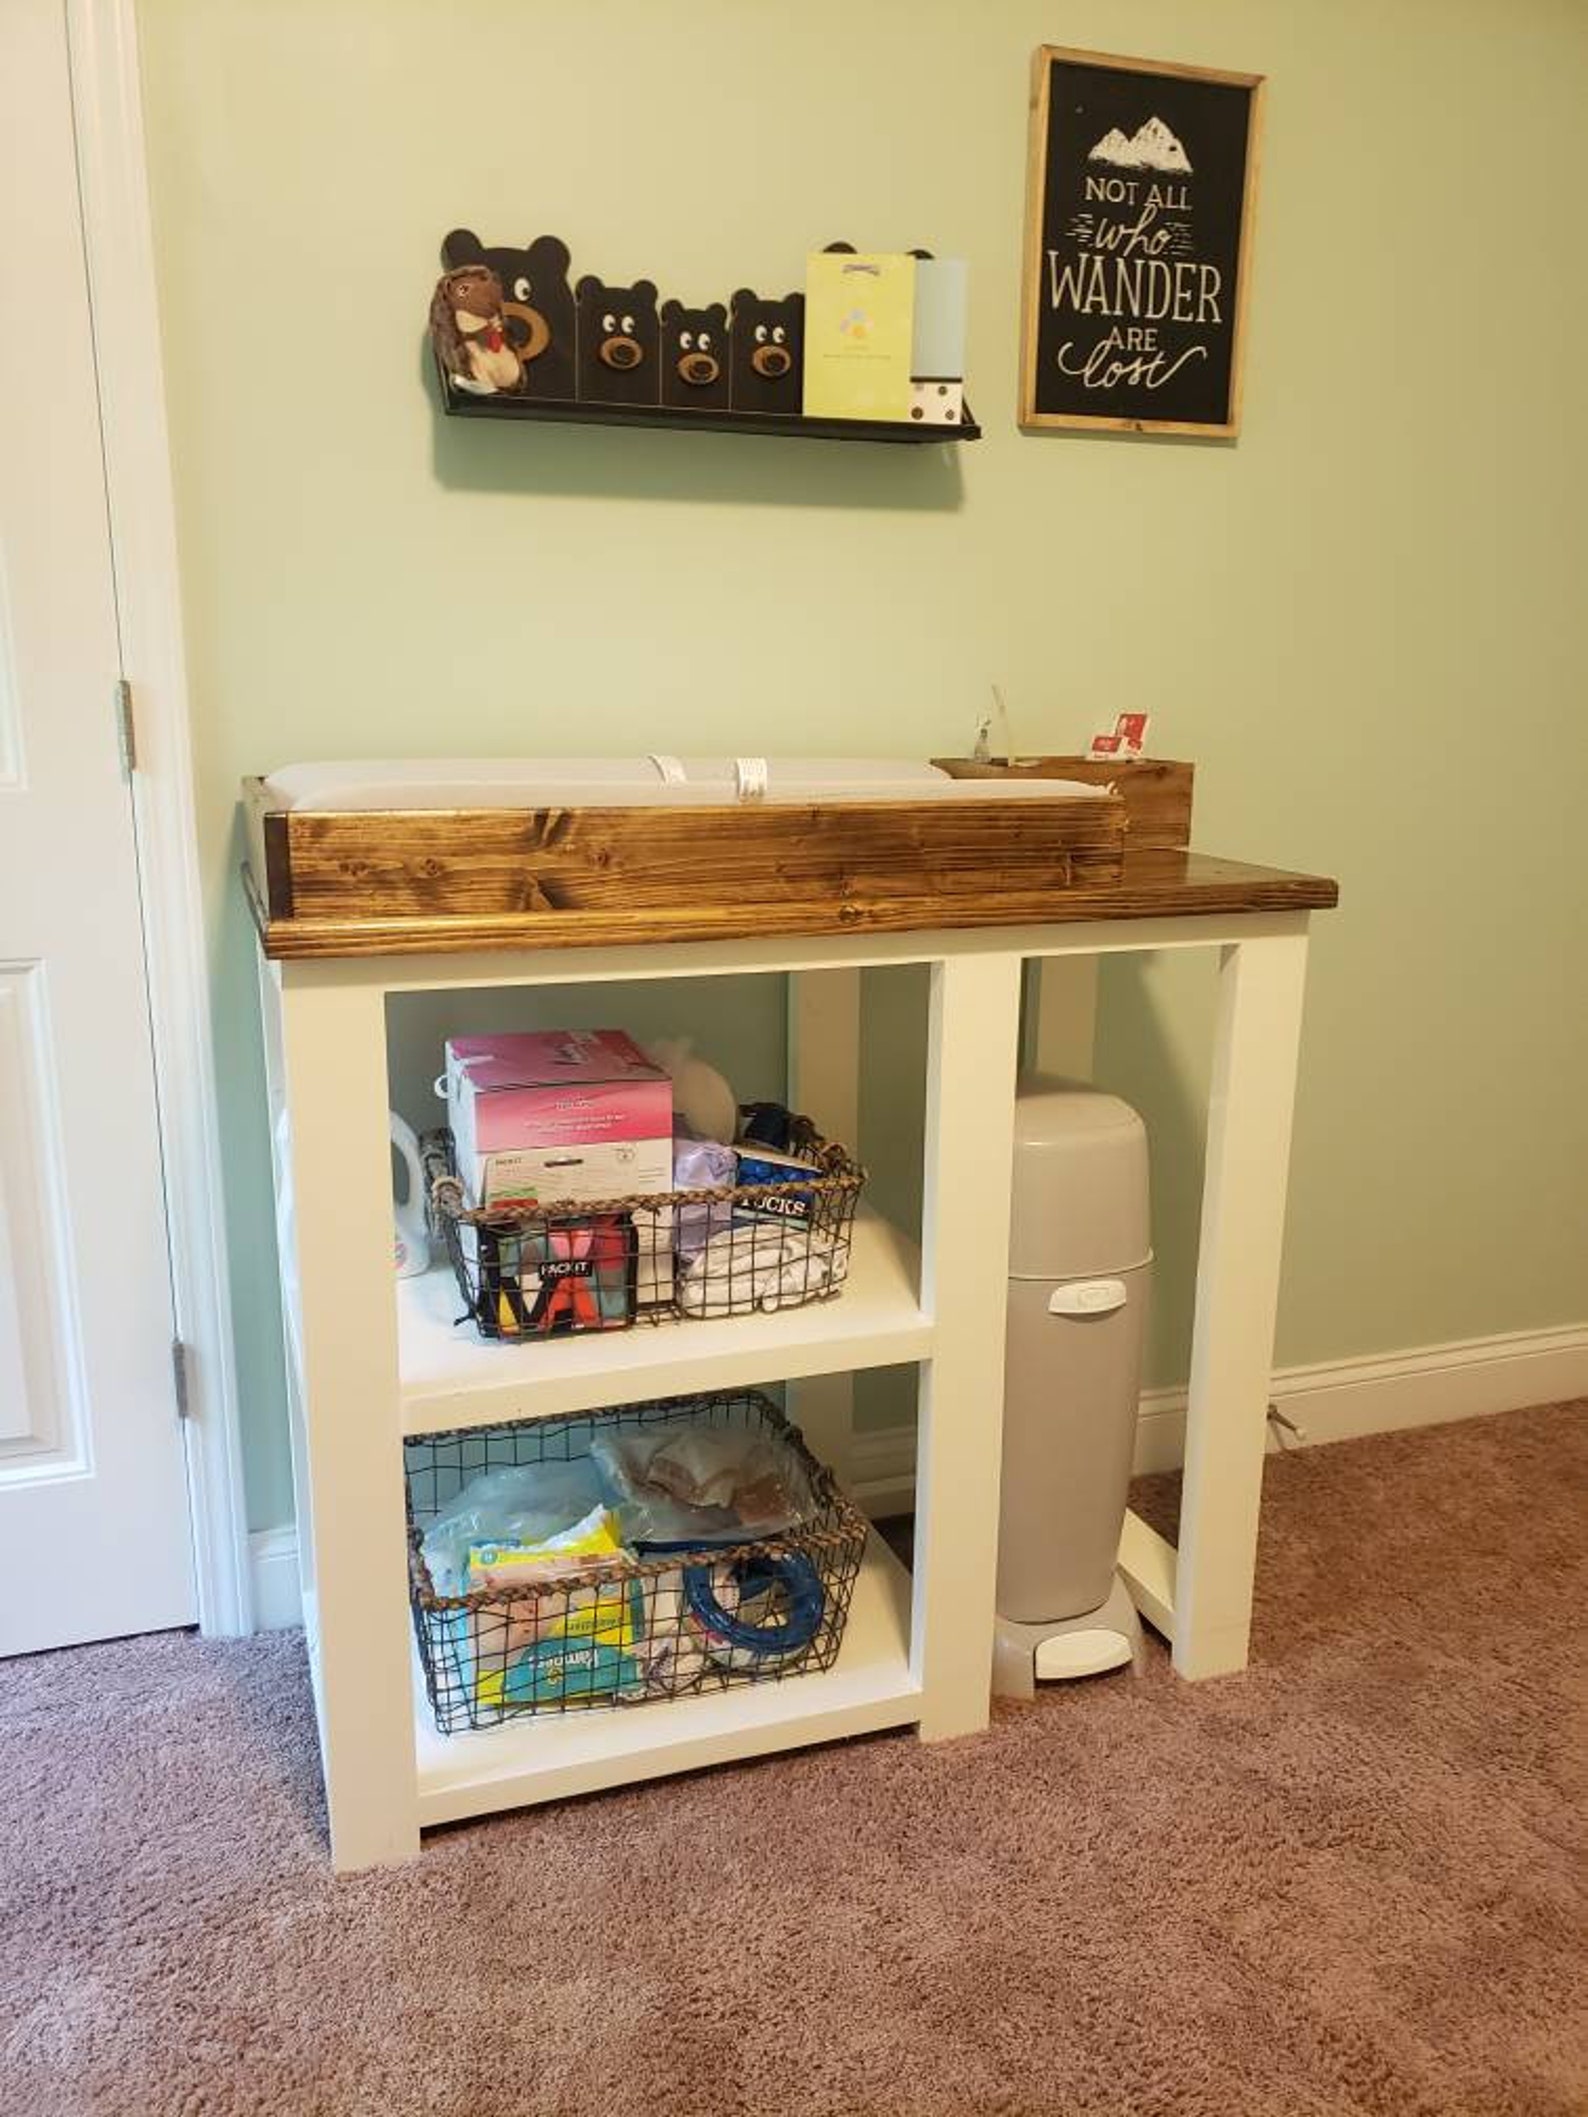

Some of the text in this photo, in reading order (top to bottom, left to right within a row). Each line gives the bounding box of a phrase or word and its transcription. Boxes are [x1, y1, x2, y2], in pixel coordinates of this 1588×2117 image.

[1085, 176, 1193, 210] NOT ALL
[1095, 204, 1172, 257] who
[1047, 250, 1223, 324] WANDER
[1108, 325, 1159, 351] ARE
[1058, 340, 1208, 388] lost
